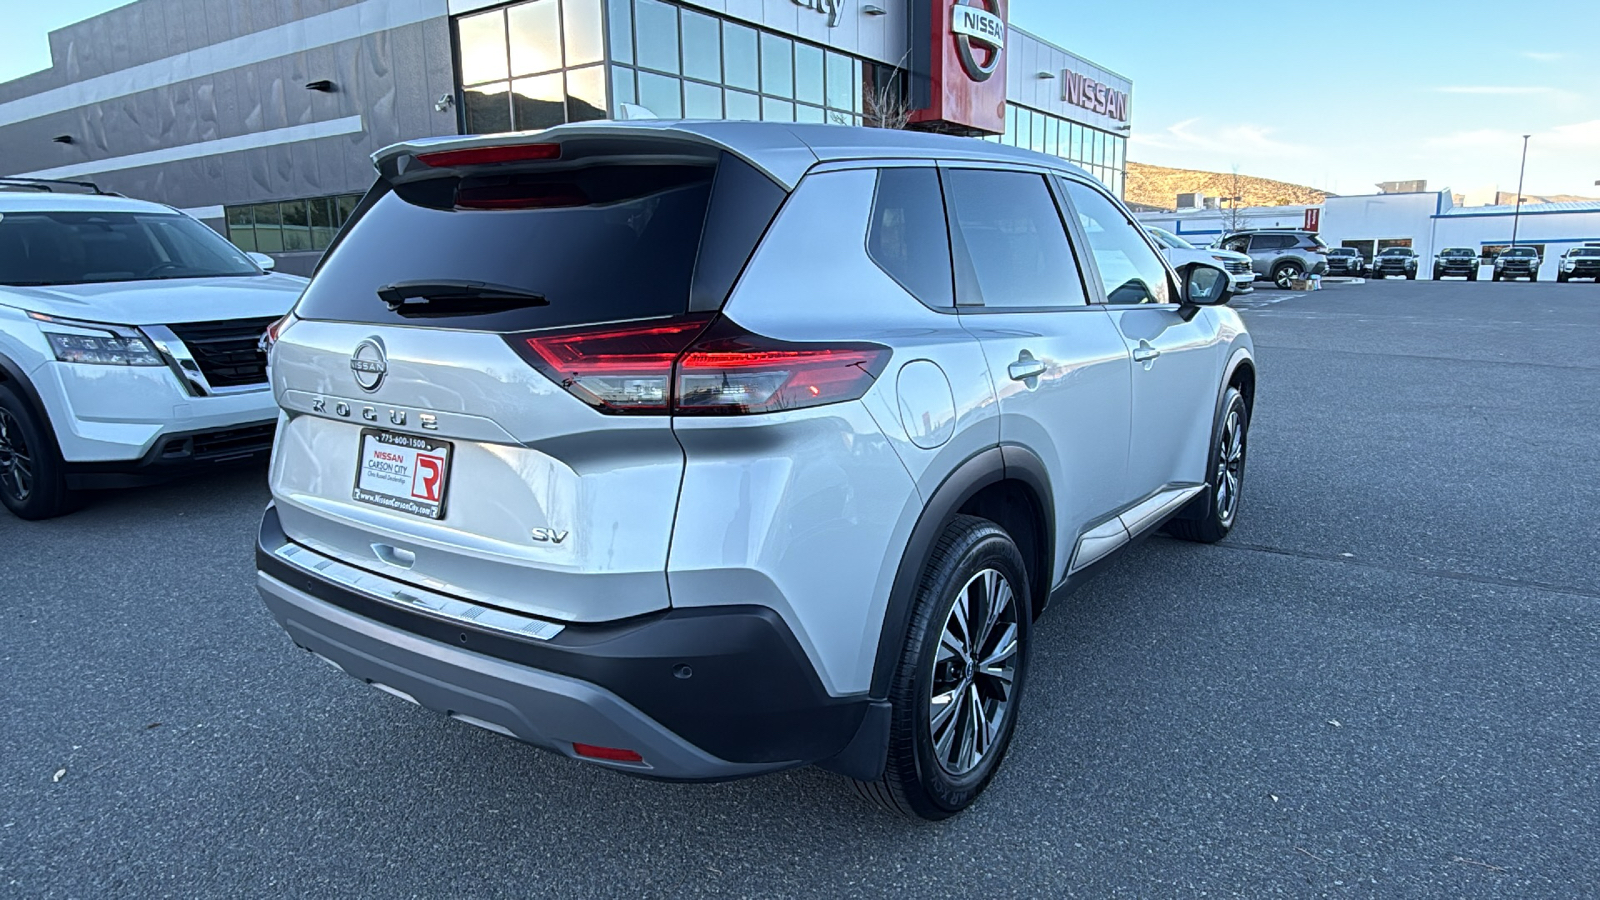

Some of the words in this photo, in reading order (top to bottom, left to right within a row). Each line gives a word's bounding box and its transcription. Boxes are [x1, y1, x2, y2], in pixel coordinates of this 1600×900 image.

[1061, 69, 1128, 122] NISSAN
[352, 361, 384, 372] NISSAN
[313, 399, 438, 430] ROGUE
[381, 433, 426, 448] 775-600-1500
[374, 450, 404, 463] NISSAN
[368, 459, 394, 472] CARSON
[394, 464, 408, 475] CITY
[360, 493, 431, 514] www.NissanCarsonCity.com
[531, 527, 569, 544] SV
